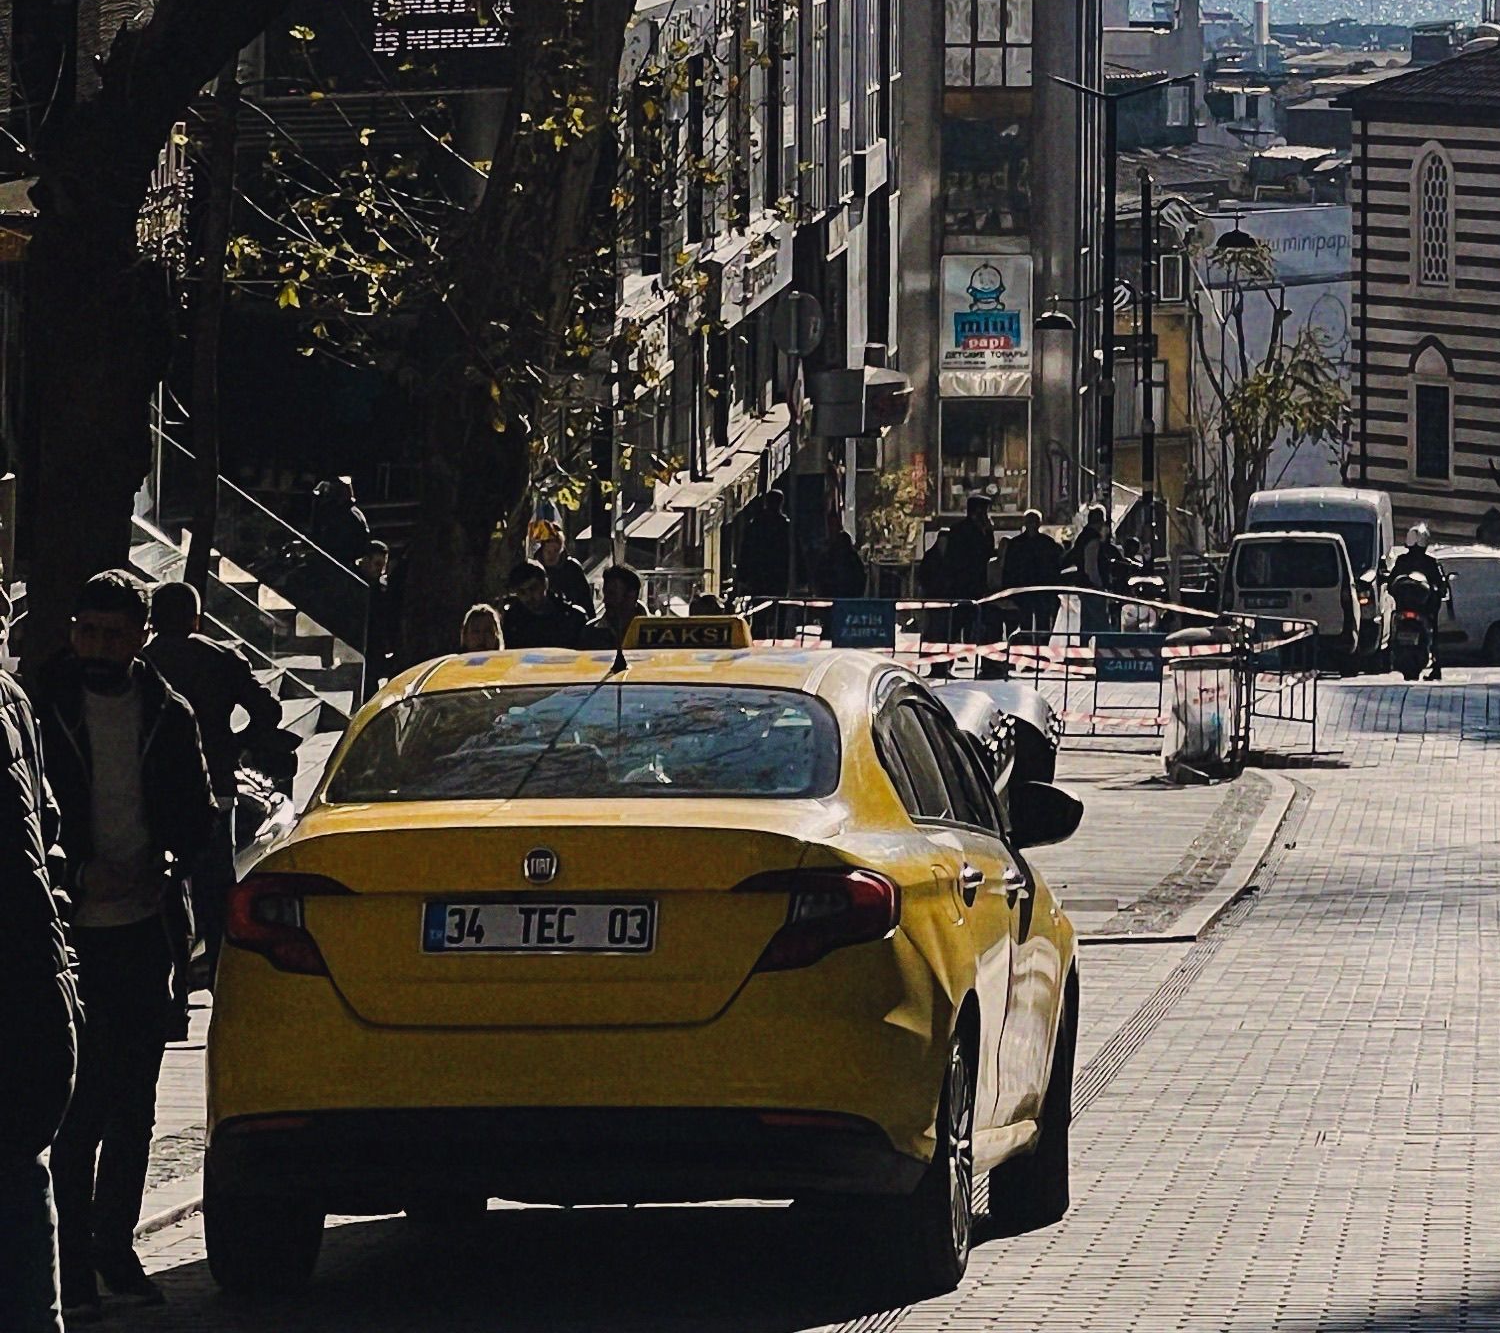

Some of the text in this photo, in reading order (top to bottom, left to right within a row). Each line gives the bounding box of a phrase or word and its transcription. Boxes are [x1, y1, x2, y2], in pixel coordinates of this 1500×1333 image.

[406, 27, 510, 50] MERKEZ
[961, 316, 1013, 333] mini
[968, 336, 1005, 350] papi
[530, 857, 552, 876] FIAT
[446, 906, 649, 945] 34 TEC 03
